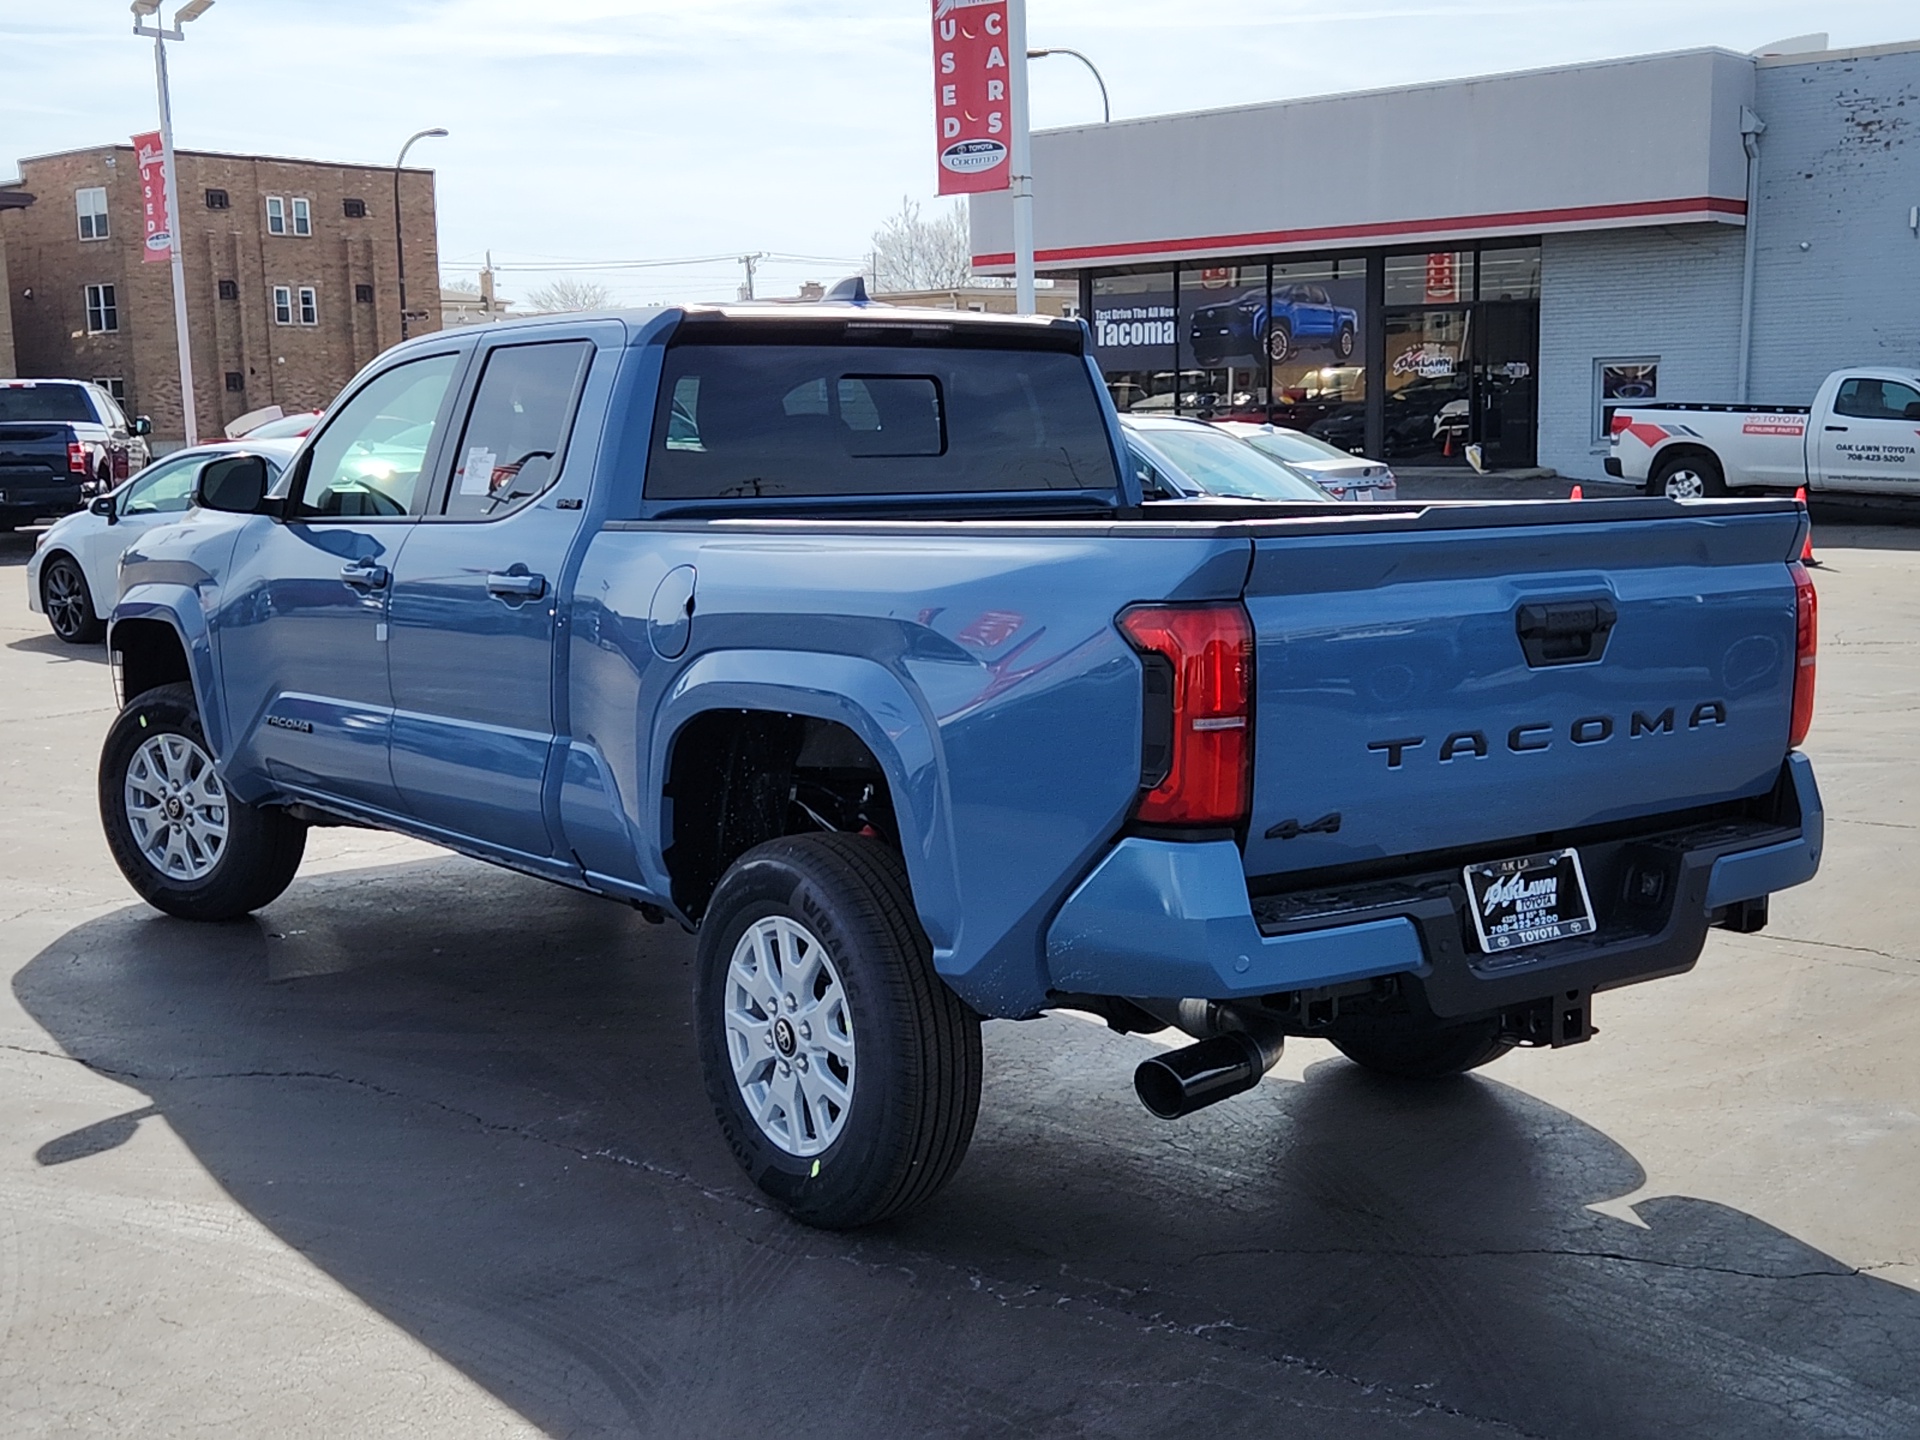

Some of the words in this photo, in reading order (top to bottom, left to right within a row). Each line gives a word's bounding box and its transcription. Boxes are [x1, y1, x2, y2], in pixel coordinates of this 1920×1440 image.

[940, 18, 960, 138] USED
[984, 12, 1005, 134] CARS
[968, 143, 994, 152] TOYOTA
[142, 168, 156, 232] USED
[1095, 309, 1112, 320] Test
[1112, 308, 1132, 320] Drive
[1132, 307, 1147, 319] The
[1148, 306, 1159, 318] All
[1095, 319, 1176, 347] Tacoma
[1763, 415, 1805, 424] TOYOTA
[1745, 425, 1776, 433] GENUINE
[1777, 426, 1801, 434] PARTS
[1836, 443, 1854, 452] OAK
[1855, 444, 1880, 453] LAWN
[1882, 445, 1916, 455] TOYOTA
[1846, 453, 1906, 463] 708-423-5200
[265, 714, 313, 733] TACOMA
[1366, 700, 1728, 770] TACOMA
[1519, 895, 1553, 910] TOYOTA
[1490, 913, 1559, 935] 708-423-5200
[1518, 925, 1561, 943] TOYOTA
